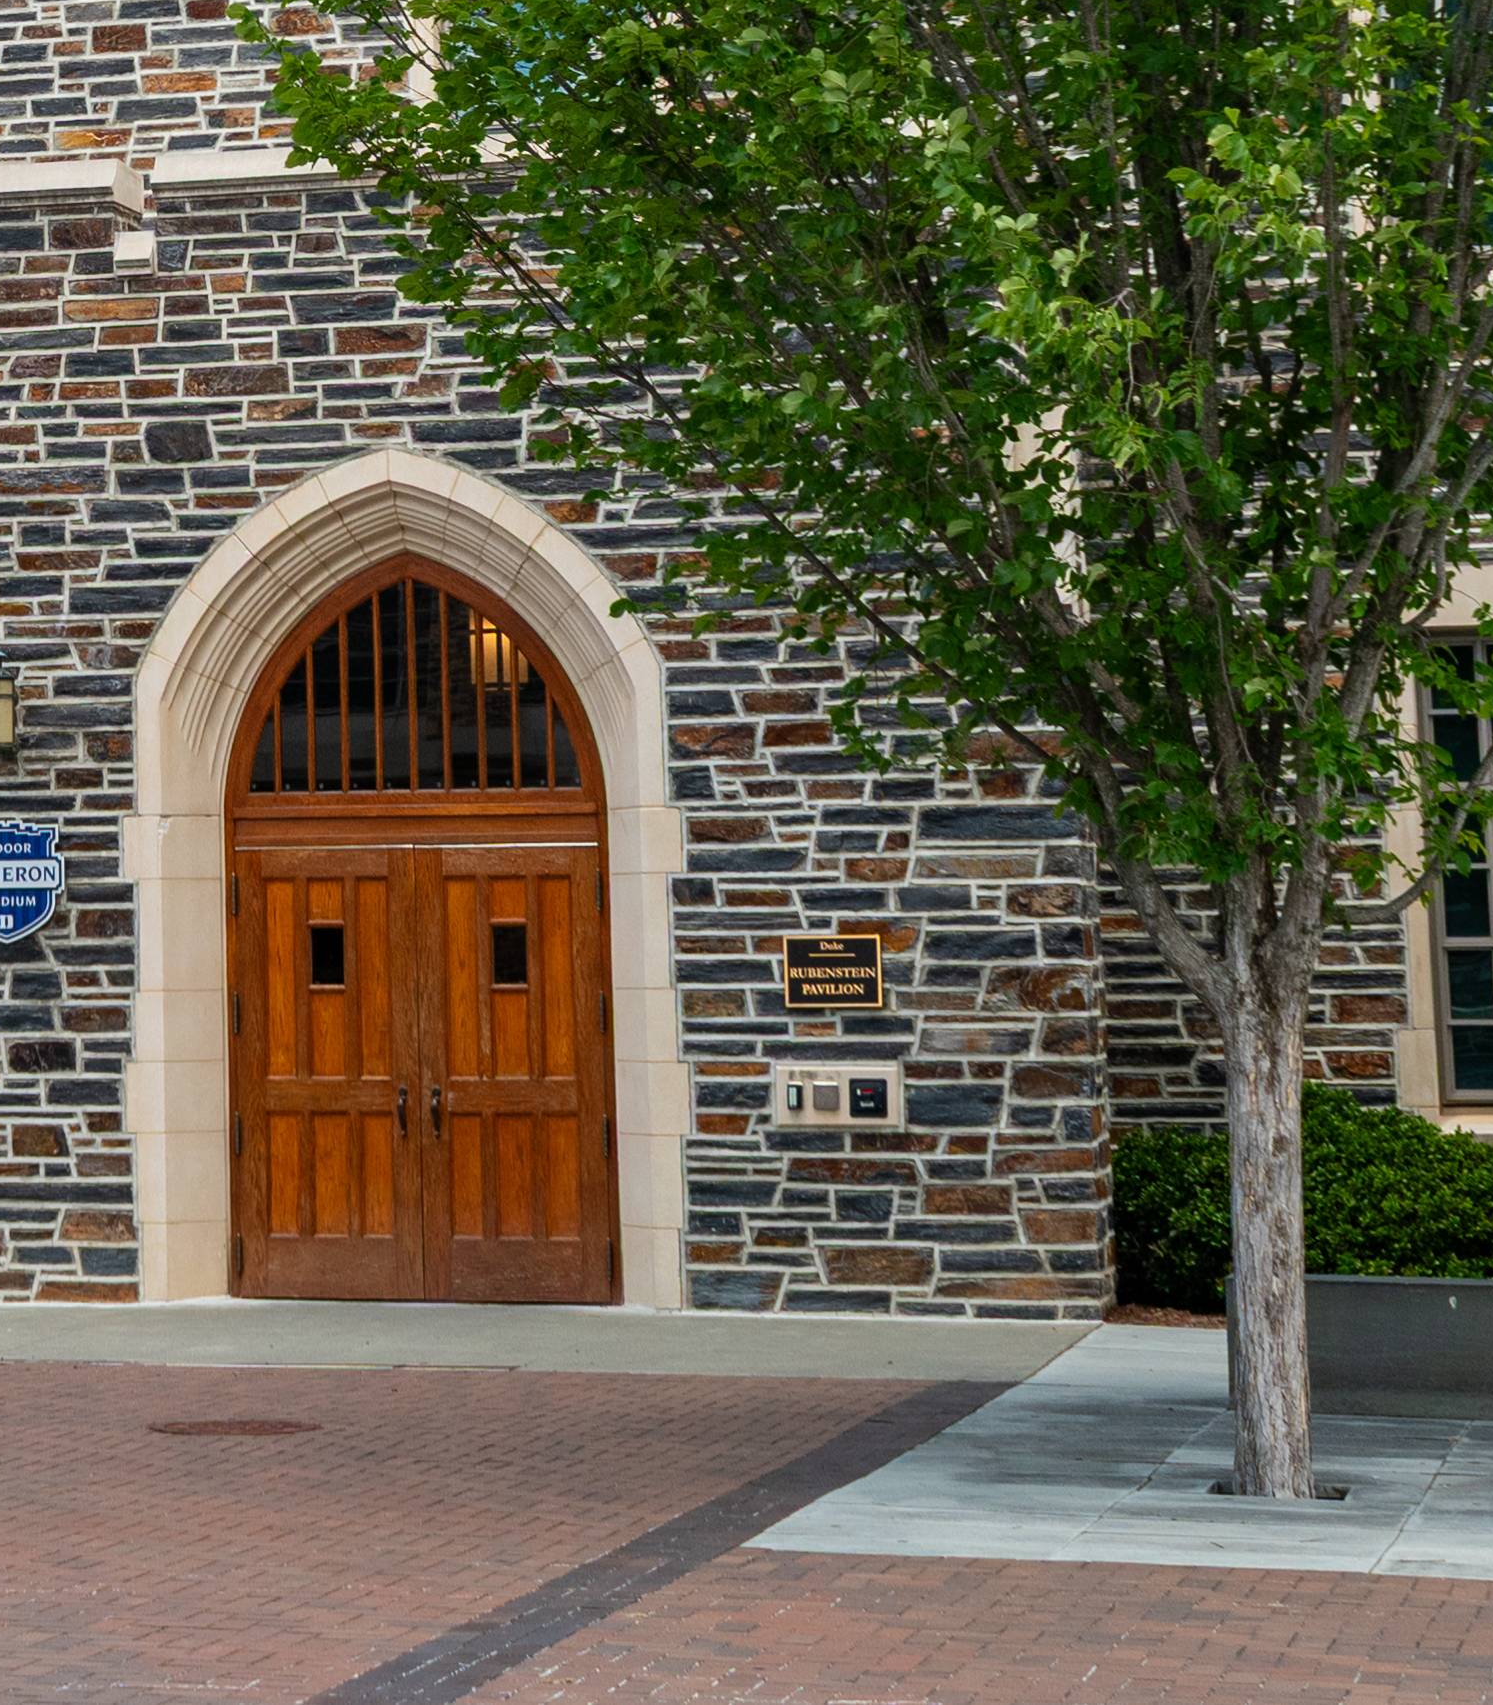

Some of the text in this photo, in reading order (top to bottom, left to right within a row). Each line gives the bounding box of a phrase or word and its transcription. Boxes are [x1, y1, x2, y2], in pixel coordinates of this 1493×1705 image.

[819, 940, 845, 951] Duke
[789, 966, 876, 979] RUBENSTEIN
[801, 982, 865, 996] PAVILION
